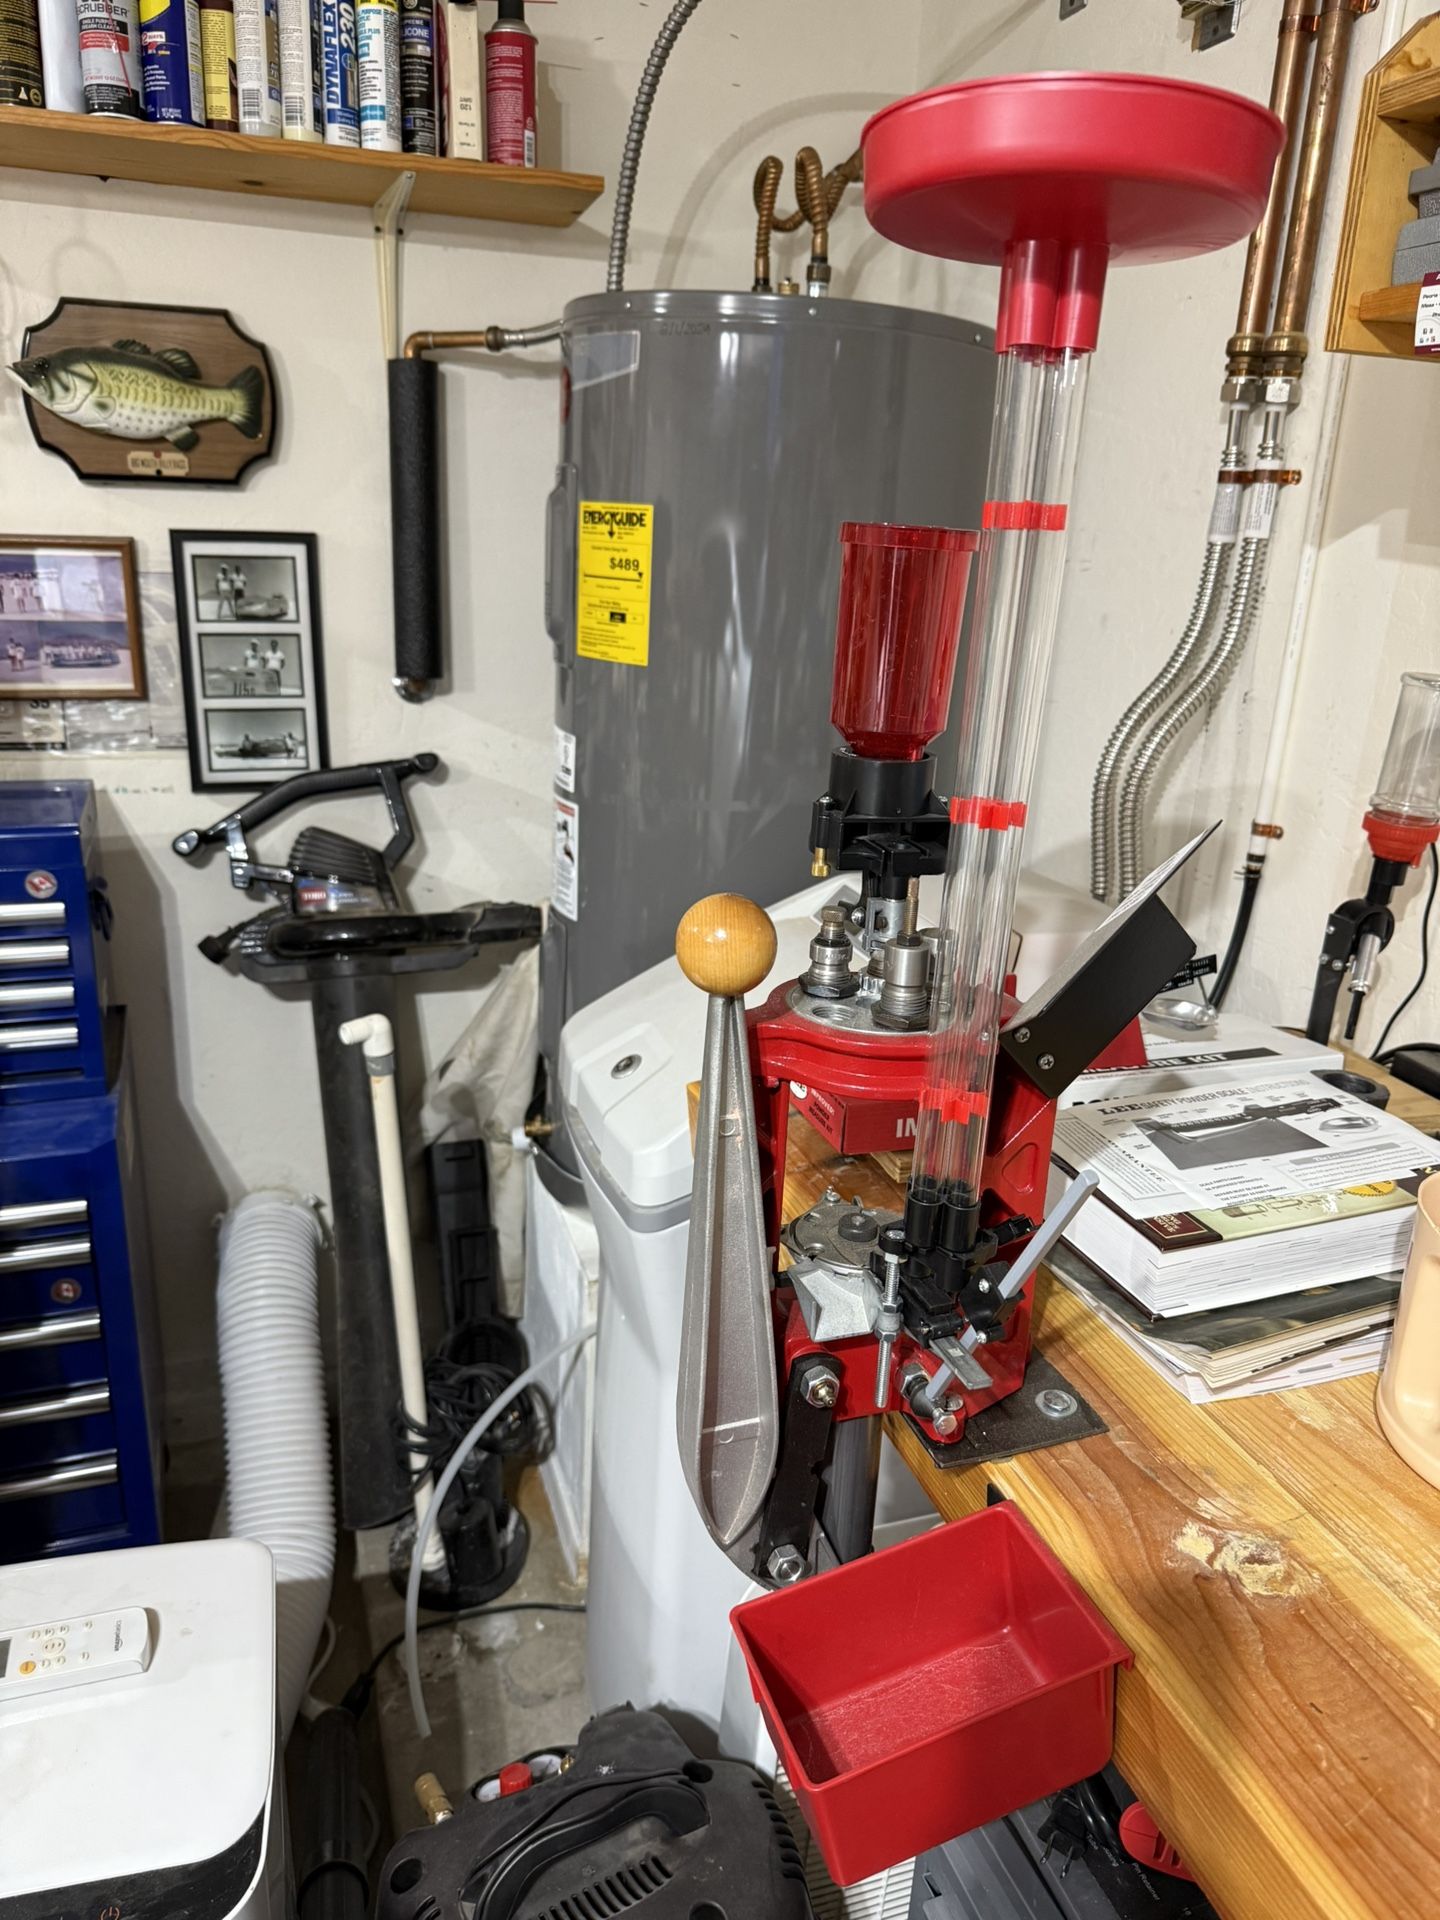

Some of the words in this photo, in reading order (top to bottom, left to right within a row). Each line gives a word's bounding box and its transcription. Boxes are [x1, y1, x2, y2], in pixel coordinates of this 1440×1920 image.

[339, 2, 356, 55] 230
[321, 0, 340, 105] DYNAFLEX
[609, 556, 640, 572] $489
[1187, 1053, 1228, 1064] KIT
[1097, 1103, 1142, 1115] LEE
[1176, 1093, 1218, 1105] POWDER
[1216, 1087, 1249, 1099] SCALE
